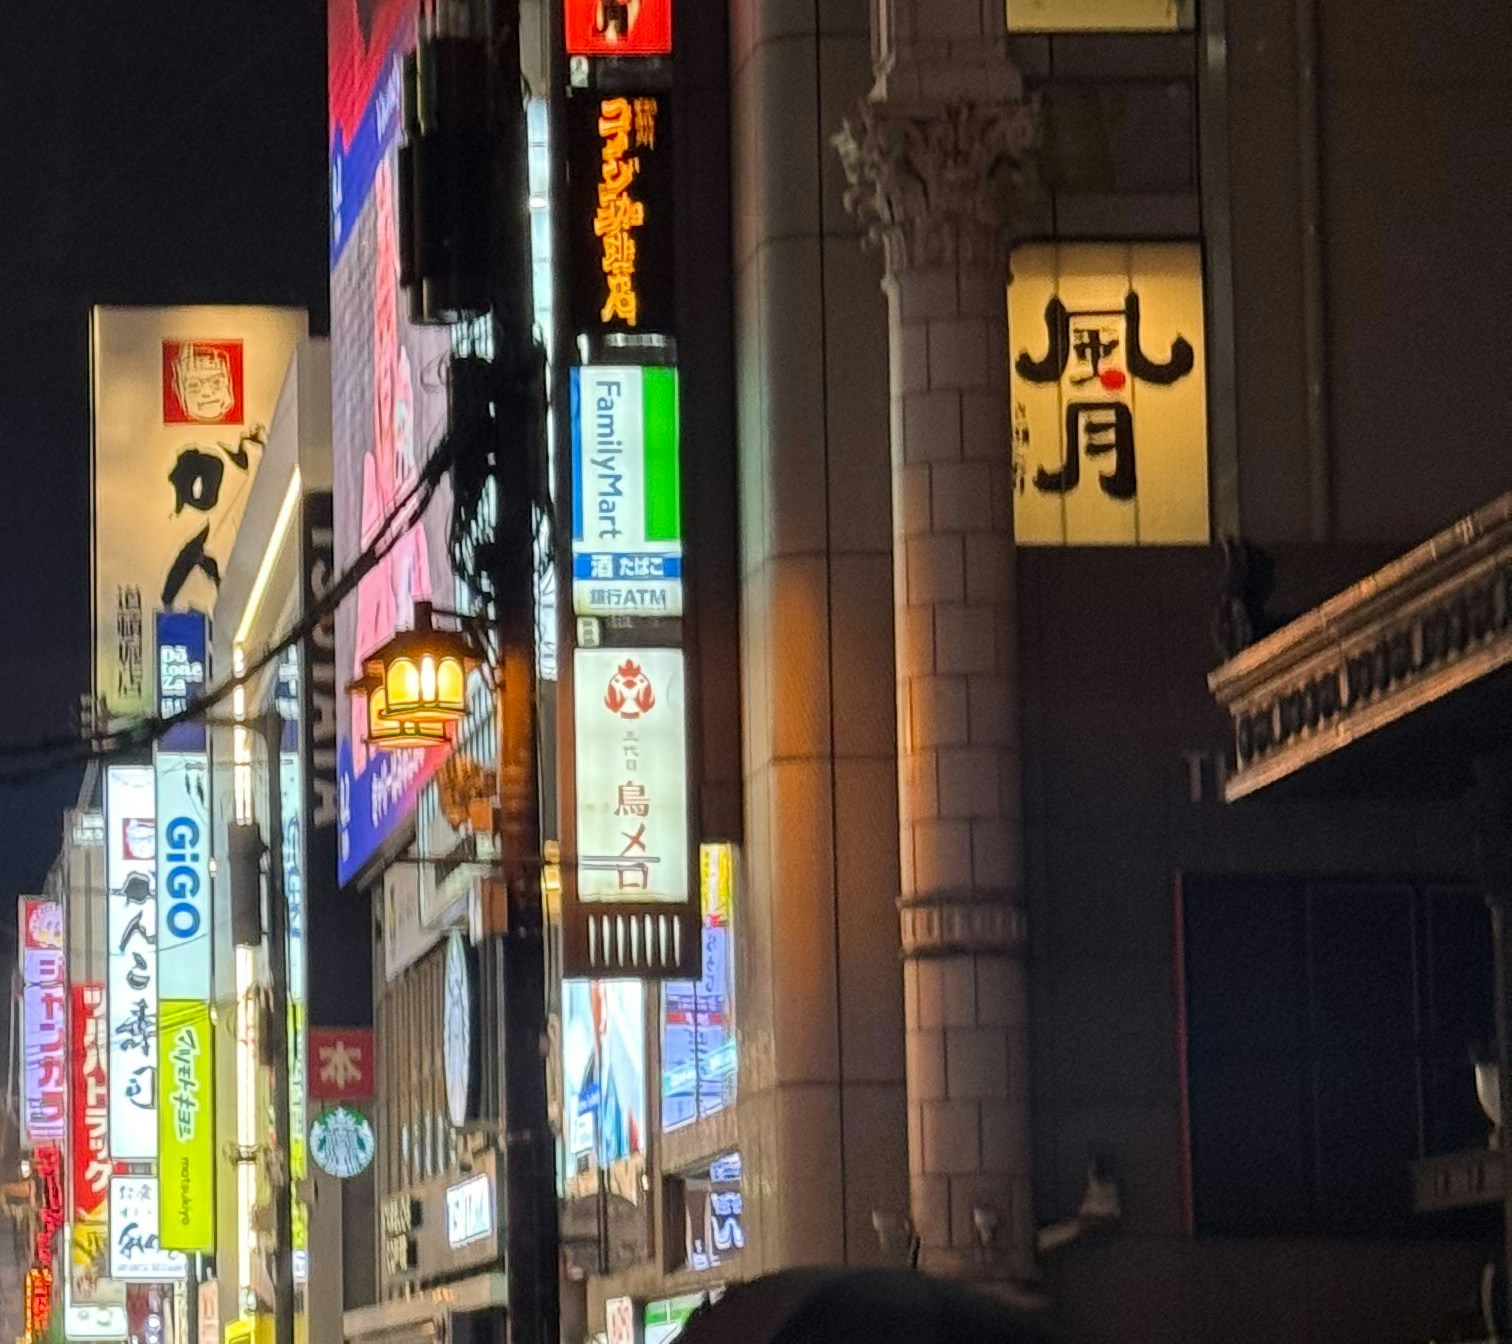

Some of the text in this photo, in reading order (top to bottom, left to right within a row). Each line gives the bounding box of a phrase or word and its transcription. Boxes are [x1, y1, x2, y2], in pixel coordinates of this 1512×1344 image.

[1014, 289, 1195, 500] 風月
[590, 381, 623, 540] FamilyMart
[589, 588, 667, 607] 銀行ATM
[590, 554, 664, 578] 酒 たばこ
[622, 730, 639, 772] 三代目
[165, 816, 201, 939] GiGO
[613, 780, 650, 890] 鳥メロ
[171, 1028, 200, 1141] マツモトキヨシ
